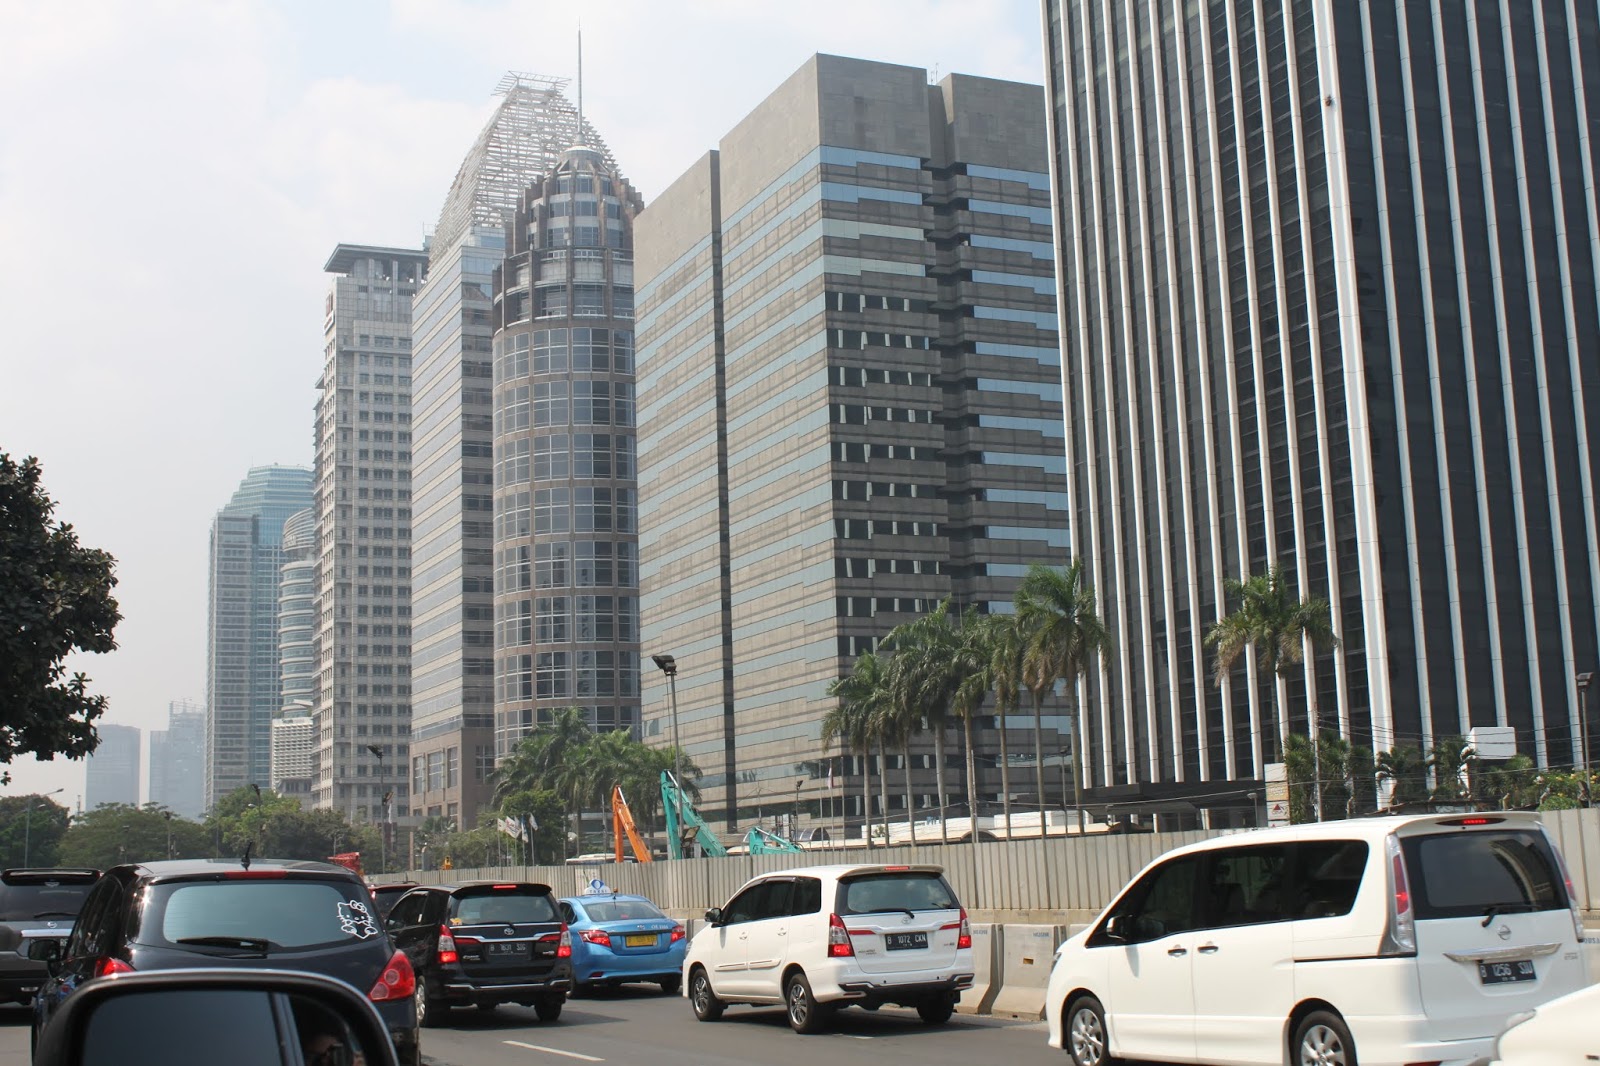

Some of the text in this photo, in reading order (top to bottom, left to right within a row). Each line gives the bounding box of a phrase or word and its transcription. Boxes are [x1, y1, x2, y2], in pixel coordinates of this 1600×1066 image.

[887, 936, 892, 944] B
[897, 935, 911, 944] 1072
[1480, 965, 1487, 977] B
[1492, 964, 1512, 976] 1256
